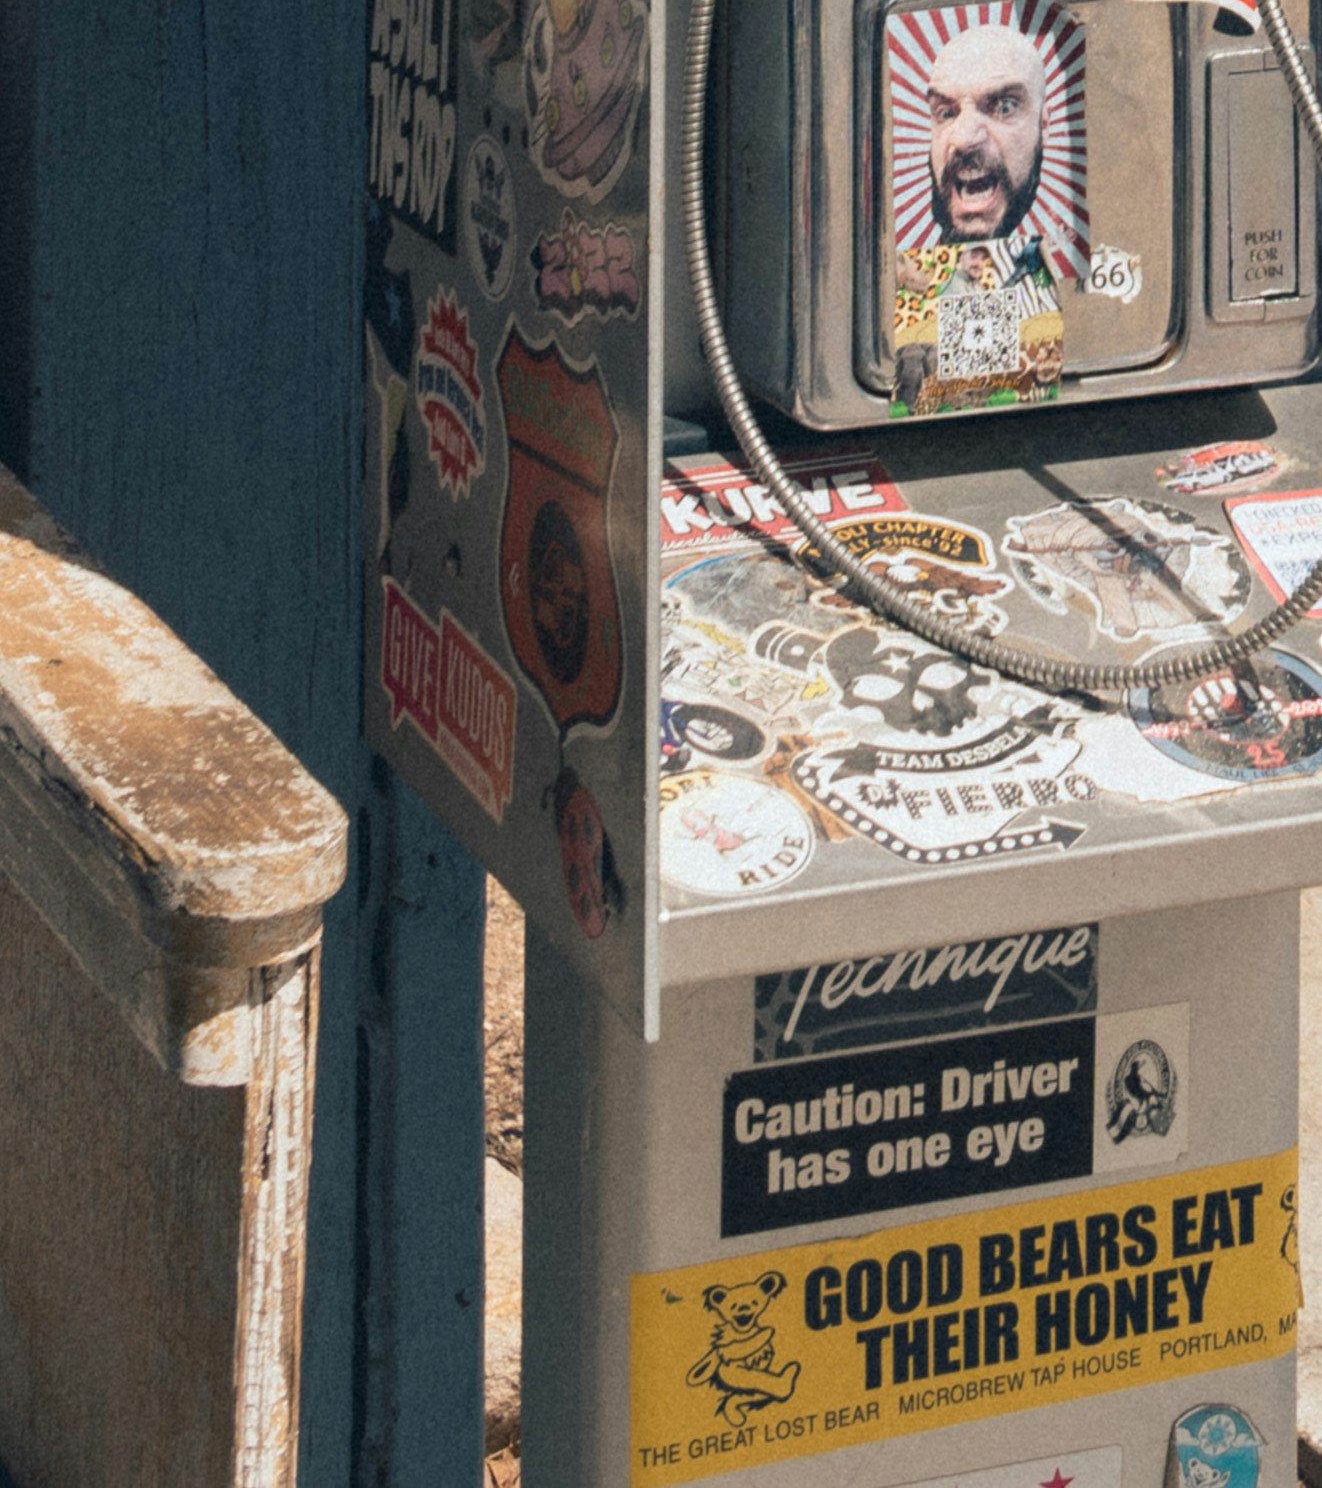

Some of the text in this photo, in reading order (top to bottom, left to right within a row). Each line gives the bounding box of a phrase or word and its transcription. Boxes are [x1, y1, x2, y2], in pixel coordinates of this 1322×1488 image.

[1243, 228, 1283, 247] PUSH
[1249, 246, 1279, 264] FOR
[1089, 263, 1125, 290] 66
[1243, 261, 1285, 283] COIN
[872, 520, 965, 544] CHAPTER
[388, 603, 434, 718] GIVE
[446, 638, 508, 772] KUDOS
[875, 749, 943, 770] TEAM
[900, 771, 1097, 822] FIERRO
[736, 833, 806, 888] RIDE
[784, 924, 1092, 1042] Technique
[734, 1058, 1079, 1145] Caution: Driver
[768, 1115, 1046, 1196] has one eye
[803, 1183, 1263, 1333] GOOD BEARS EAT
[856, 1260, 1214, 1391] THEIR HONEY
[638, 1445, 684, 1469] THE
[688, 1427, 757, 1460] GREAT
[763, 1414, 818, 1443] LOST
[824, 1402, 881, 1432] BEAR
[898, 1374, 1024, 1417] MICROBREW
[1030, 1364, 1067, 1394] TAP
[1071, 1348, 1142, 1381] HOUSE
[1159, 1325, 1269, 1362] PORTLAND,
